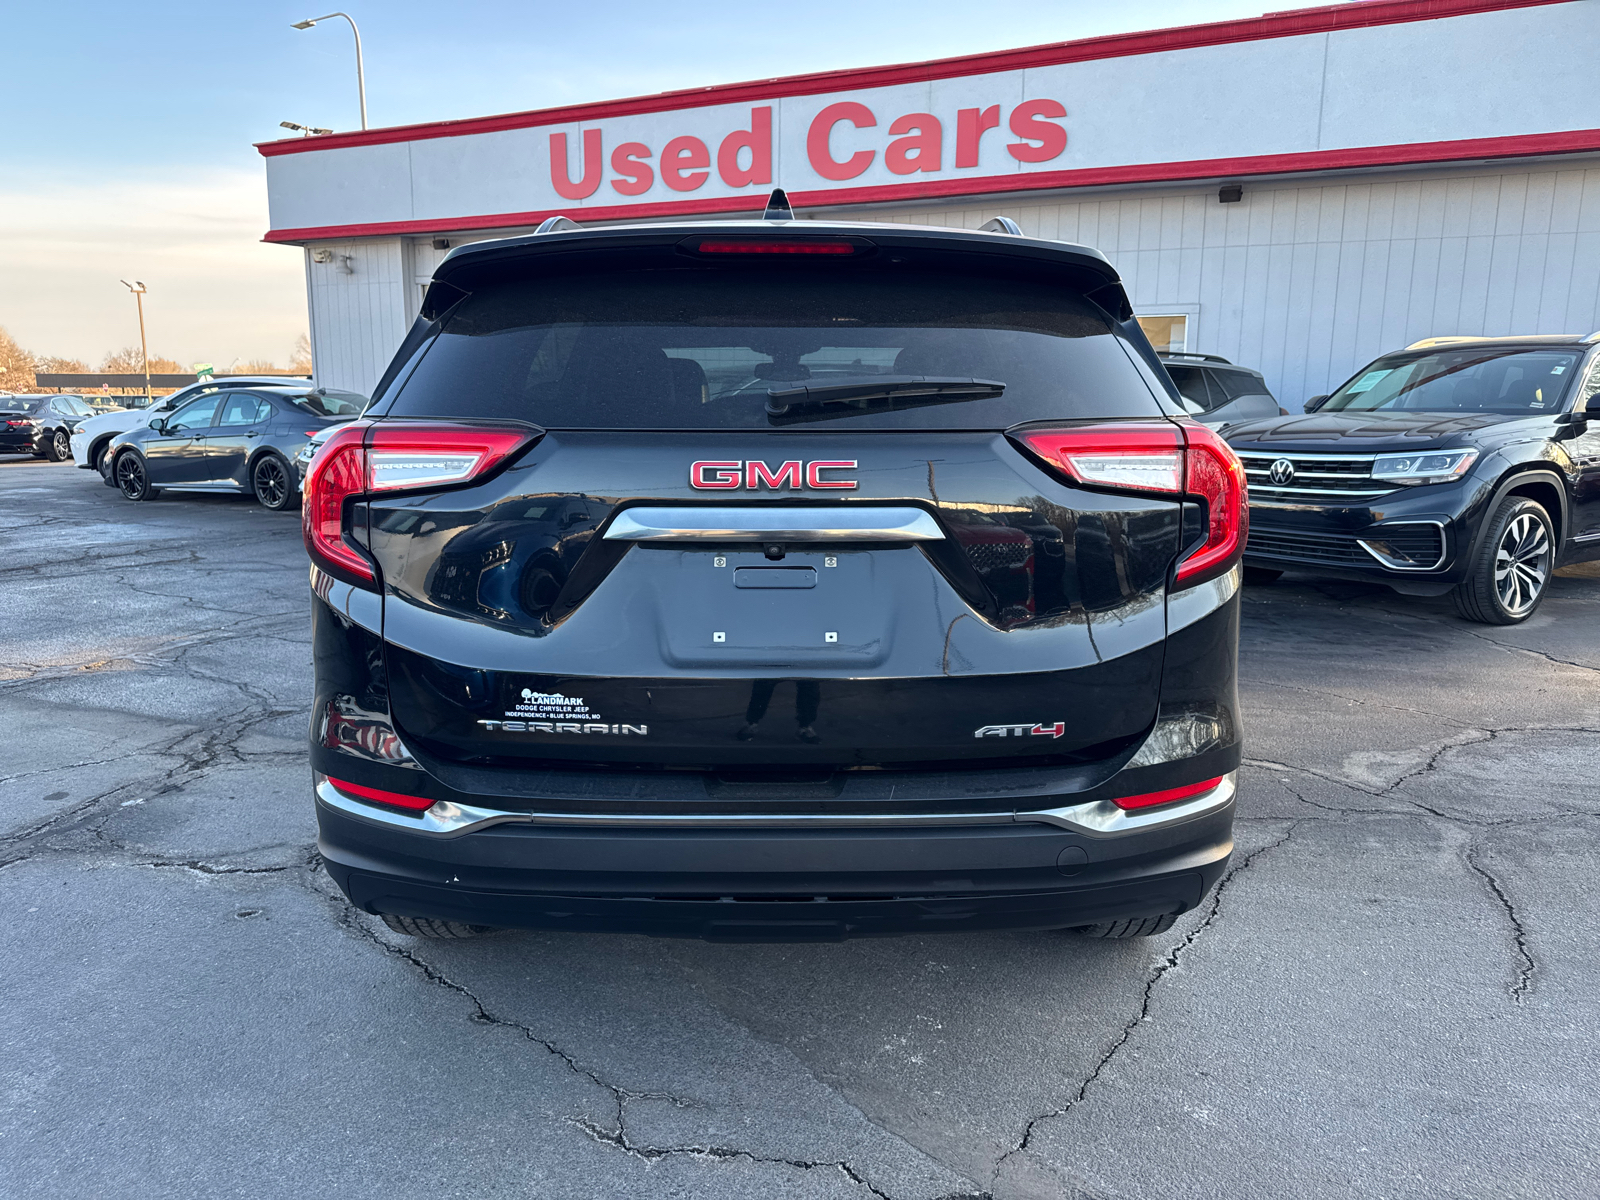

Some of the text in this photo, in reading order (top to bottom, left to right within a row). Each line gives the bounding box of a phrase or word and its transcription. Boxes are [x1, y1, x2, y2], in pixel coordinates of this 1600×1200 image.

[549, 98, 1068, 200] Used Cars
[690, 459, 858, 490] GMC
[531, 697, 583, 705] LANDMARK
[477, 720, 648, 735] TERRAIN
[974, 722, 1065, 739] AT4
